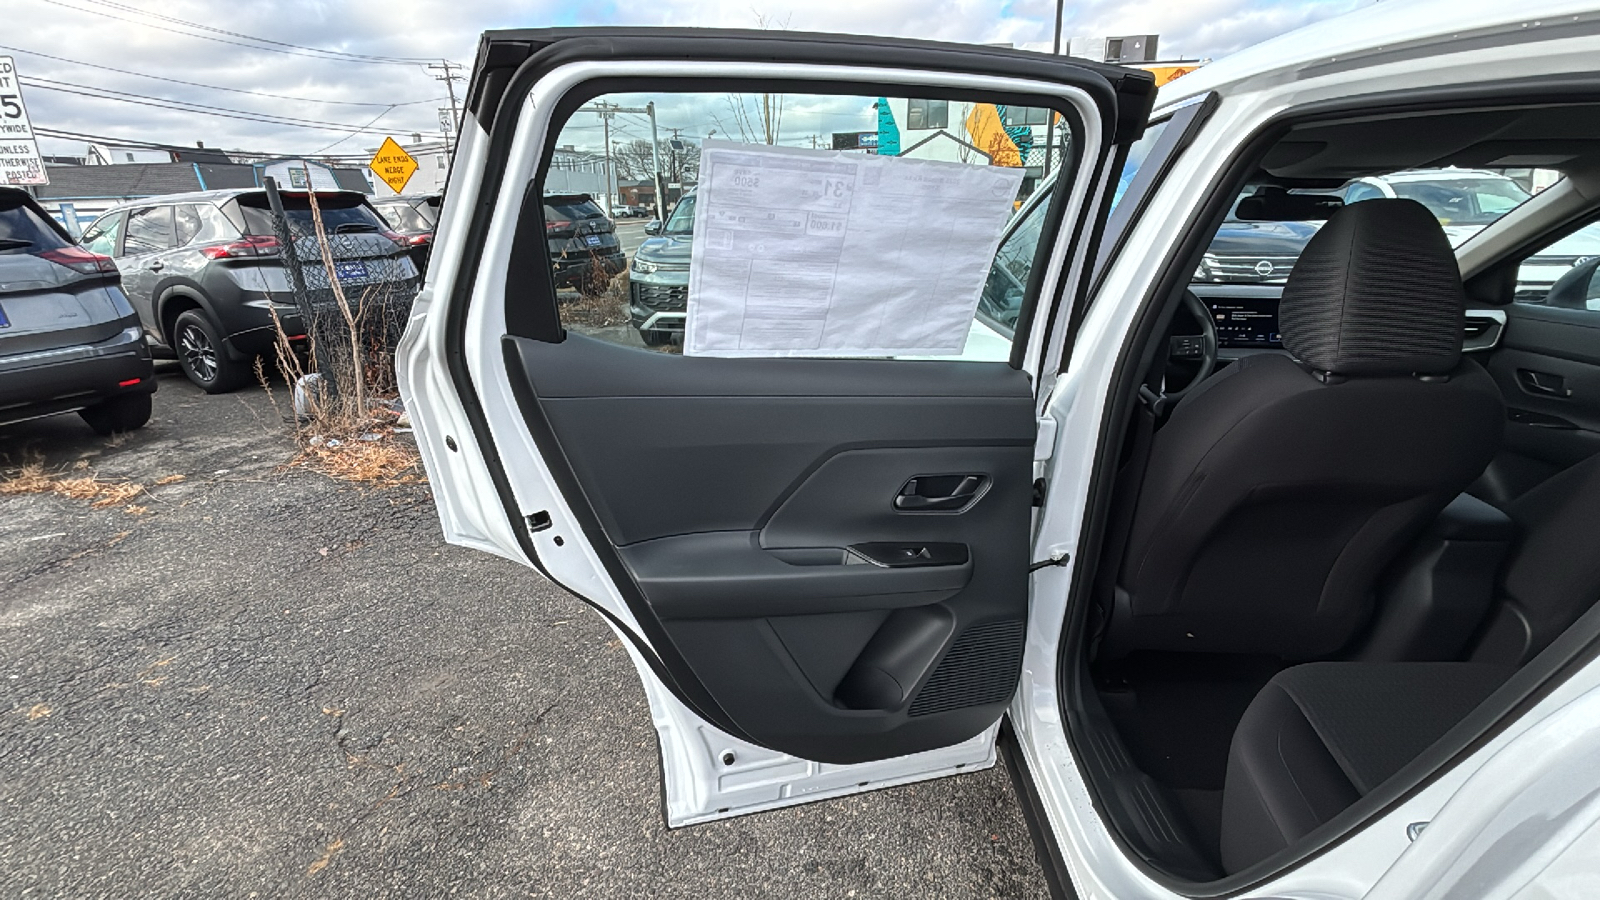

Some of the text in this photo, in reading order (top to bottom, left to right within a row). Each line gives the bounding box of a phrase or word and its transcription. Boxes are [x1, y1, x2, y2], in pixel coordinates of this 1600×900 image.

[376, 155, 409, 164] LANE ENDS
[384, 166, 404, 174] MERGE
